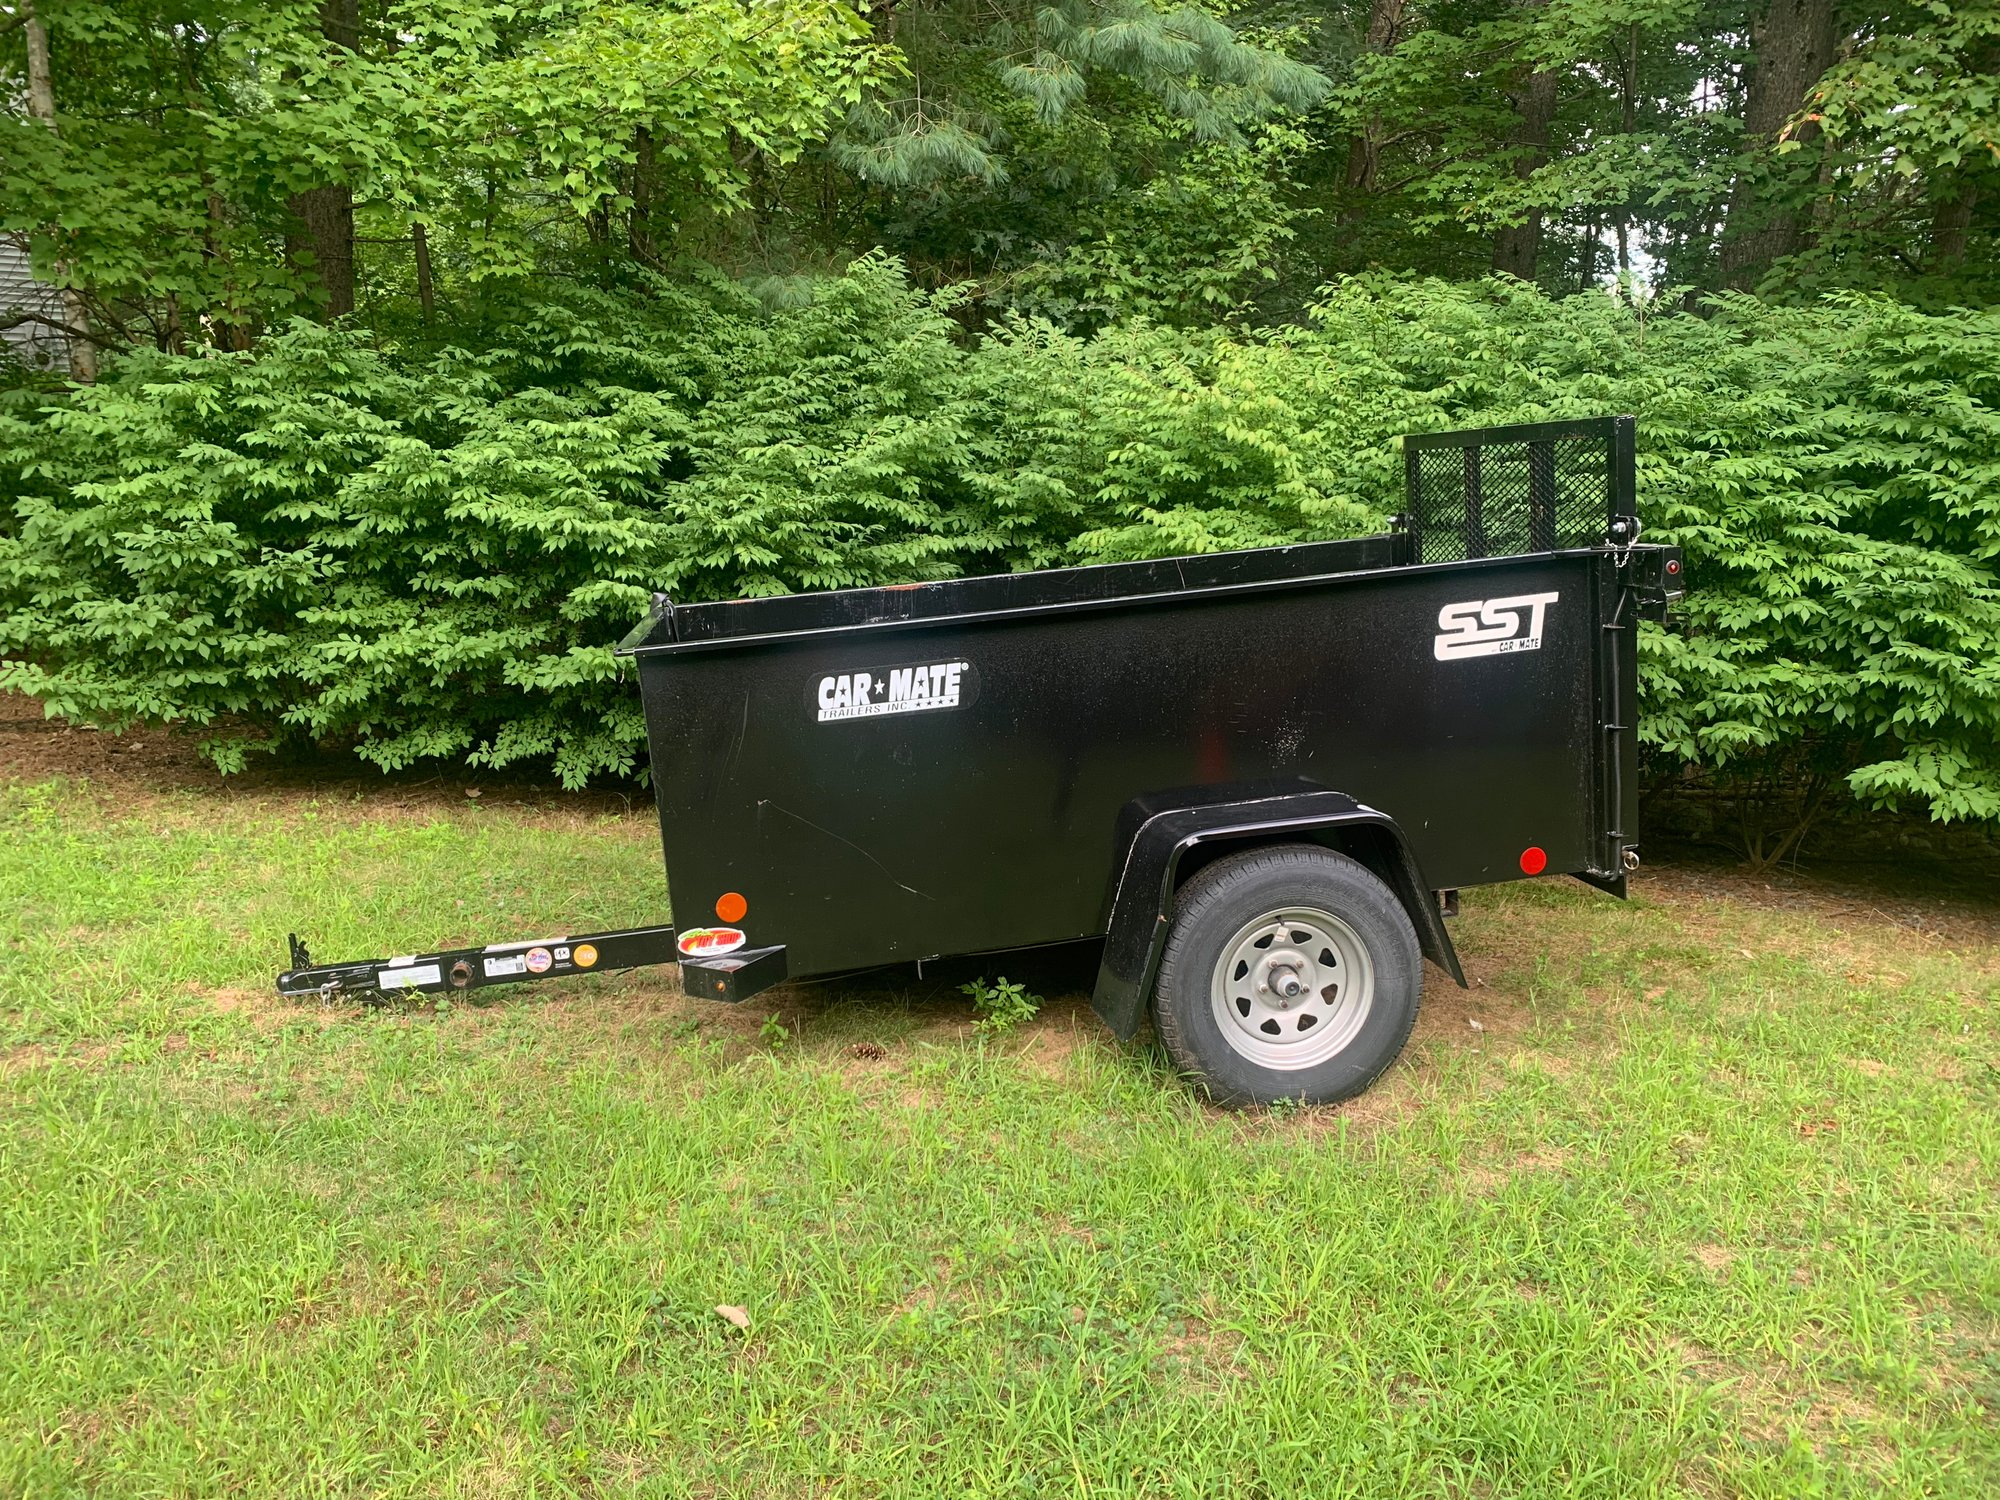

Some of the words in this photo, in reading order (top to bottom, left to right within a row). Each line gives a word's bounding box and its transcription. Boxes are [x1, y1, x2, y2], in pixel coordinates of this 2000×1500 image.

[1434, 592, 1559, 661] SST
[1499, 641, 1514, 652] CAR
[1519, 638, 1539, 650] MATE
[818, 673, 872, 710] CAR
[822, 704, 881, 719] TRAILERS
[887, 702, 911, 712] INC.
